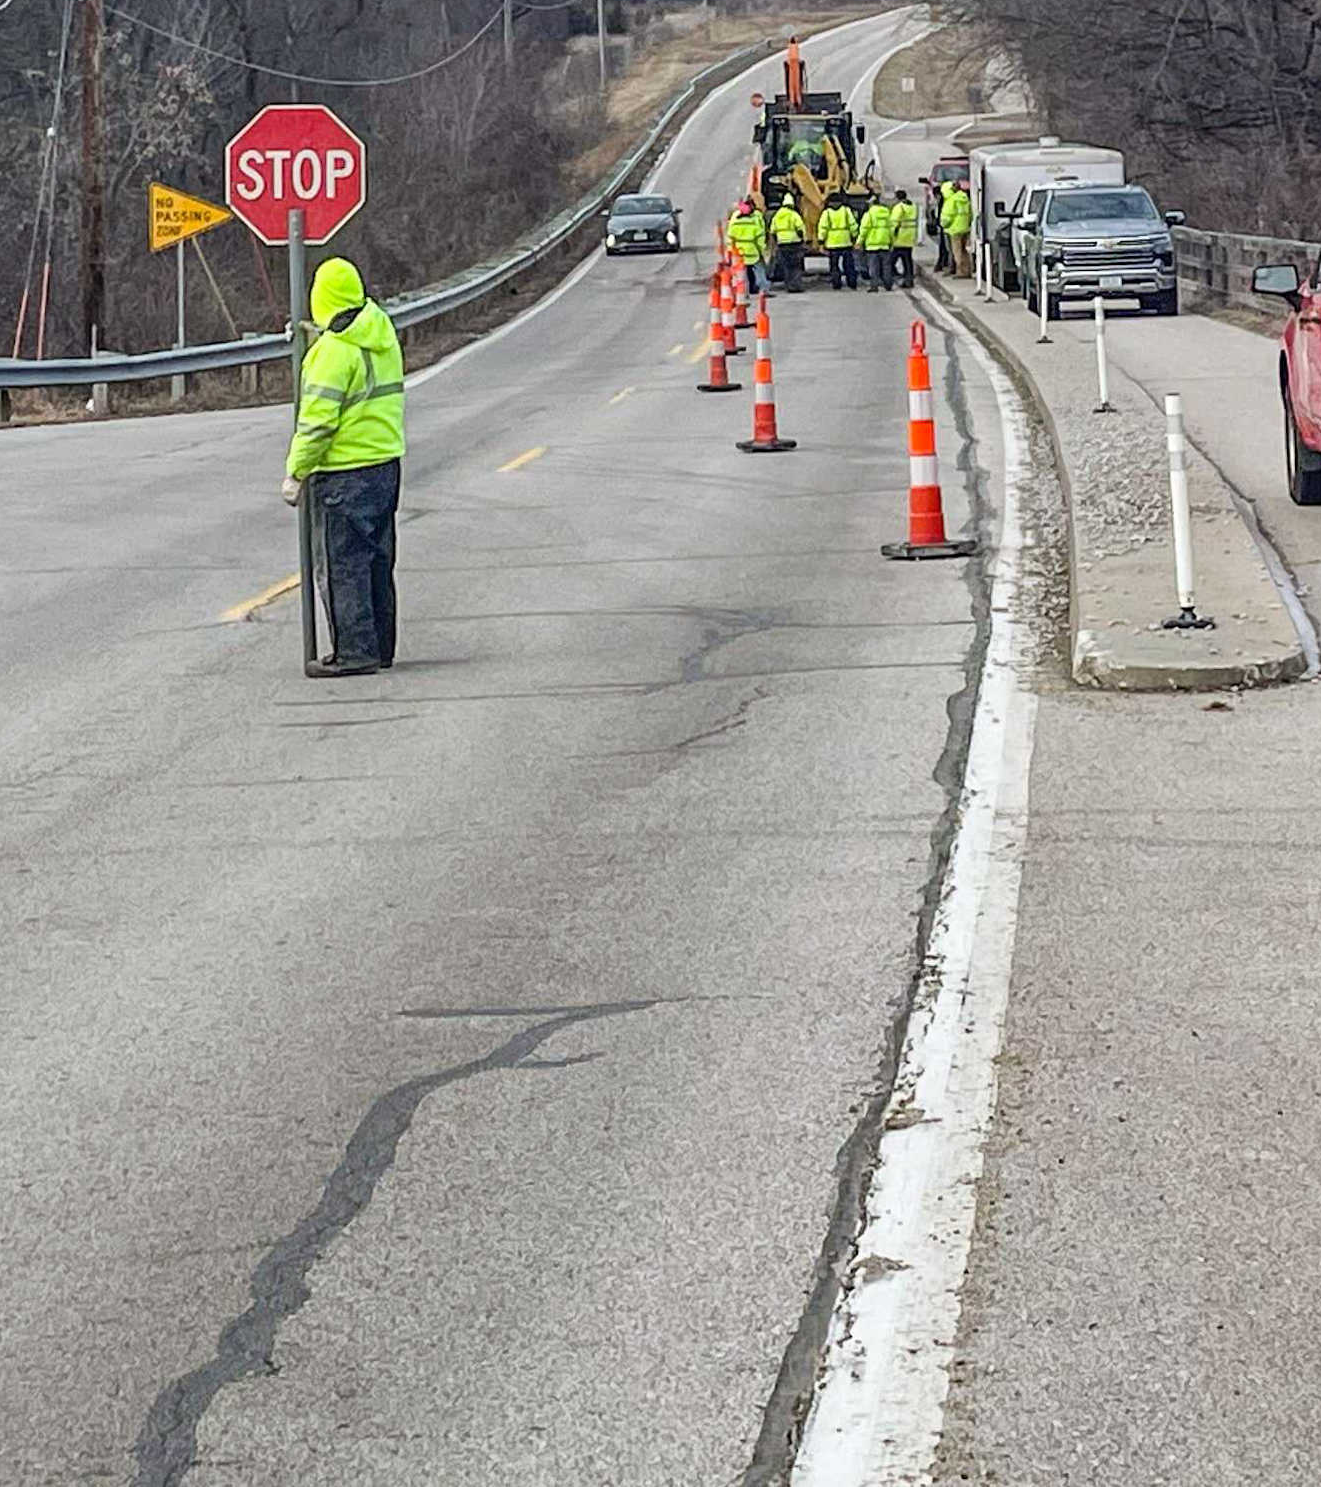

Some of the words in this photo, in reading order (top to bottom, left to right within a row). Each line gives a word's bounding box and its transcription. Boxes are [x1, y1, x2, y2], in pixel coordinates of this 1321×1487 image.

[236, 149, 355, 200] STOP
[156, 197, 173, 208] NO
[156, 210, 212, 222] PASSING
